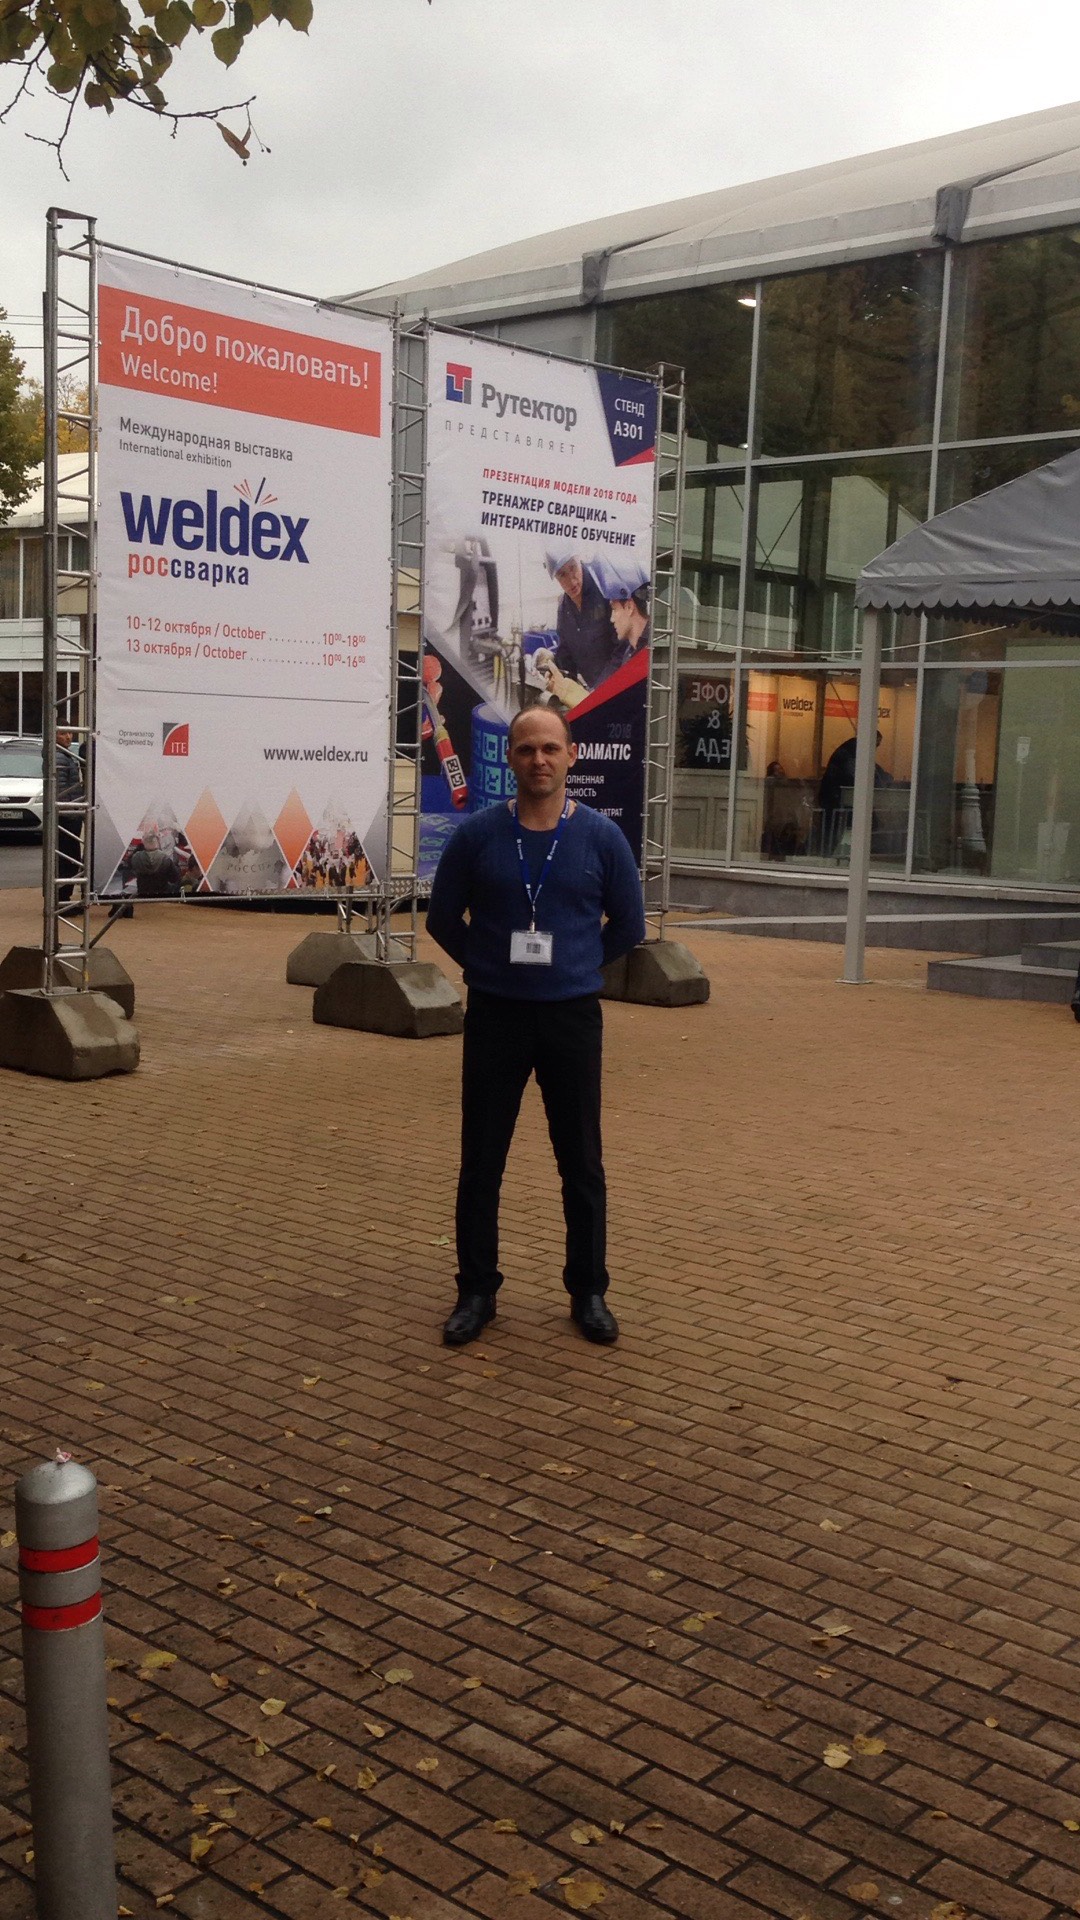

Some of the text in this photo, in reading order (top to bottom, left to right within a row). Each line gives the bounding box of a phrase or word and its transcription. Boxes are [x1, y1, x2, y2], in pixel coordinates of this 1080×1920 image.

[121, 305, 369, 389] Добро пожаловать!
[121, 352, 218, 393] Welcome!
[481, 382, 577, 431] Рутектор
[614, 398, 645, 418] СТЕНД
[119, 416, 293, 461] Международная выставка
[445, 420, 575, 455] ПРЕДСТАВЛЯЕТ
[613, 420, 643, 440] А301
[119, 439, 232, 468] International exhibition
[482, 468, 637, 504] ПРЕЗЕНТАЦИЯ МОДЕЛИ 2018 ГОДА
[482, 490, 544, 513] ТРЕНАЖЕР
[547, 501, 607, 523] СВАРЩИКА
[120, 489, 310, 564] weldex
[481, 511, 636, 547] ИНТЕРАКТИВНОЕ ОБУЧЕНИЕ
[128, 553, 249, 587] россварка
[126, 615, 161, 632] 10-12
[164, 621, 211, 638] октября
[223, 624, 266, 640] October
[126, 639, 140, 652] 13
[143, 643, 191, 659] октября
[203, 645, 247, 660] October
[783, 697, 814, 712] weldex
[171, 742, 187, 754] ITE
[263, 746, 369, 763] www.weldex.ru
[577, 742, 631, 760] DAMATIC
[565, 787, 597, 797] ЛЬНОСТЬ
[566, 774, 605, 785] ОЛНЕННАЯ
